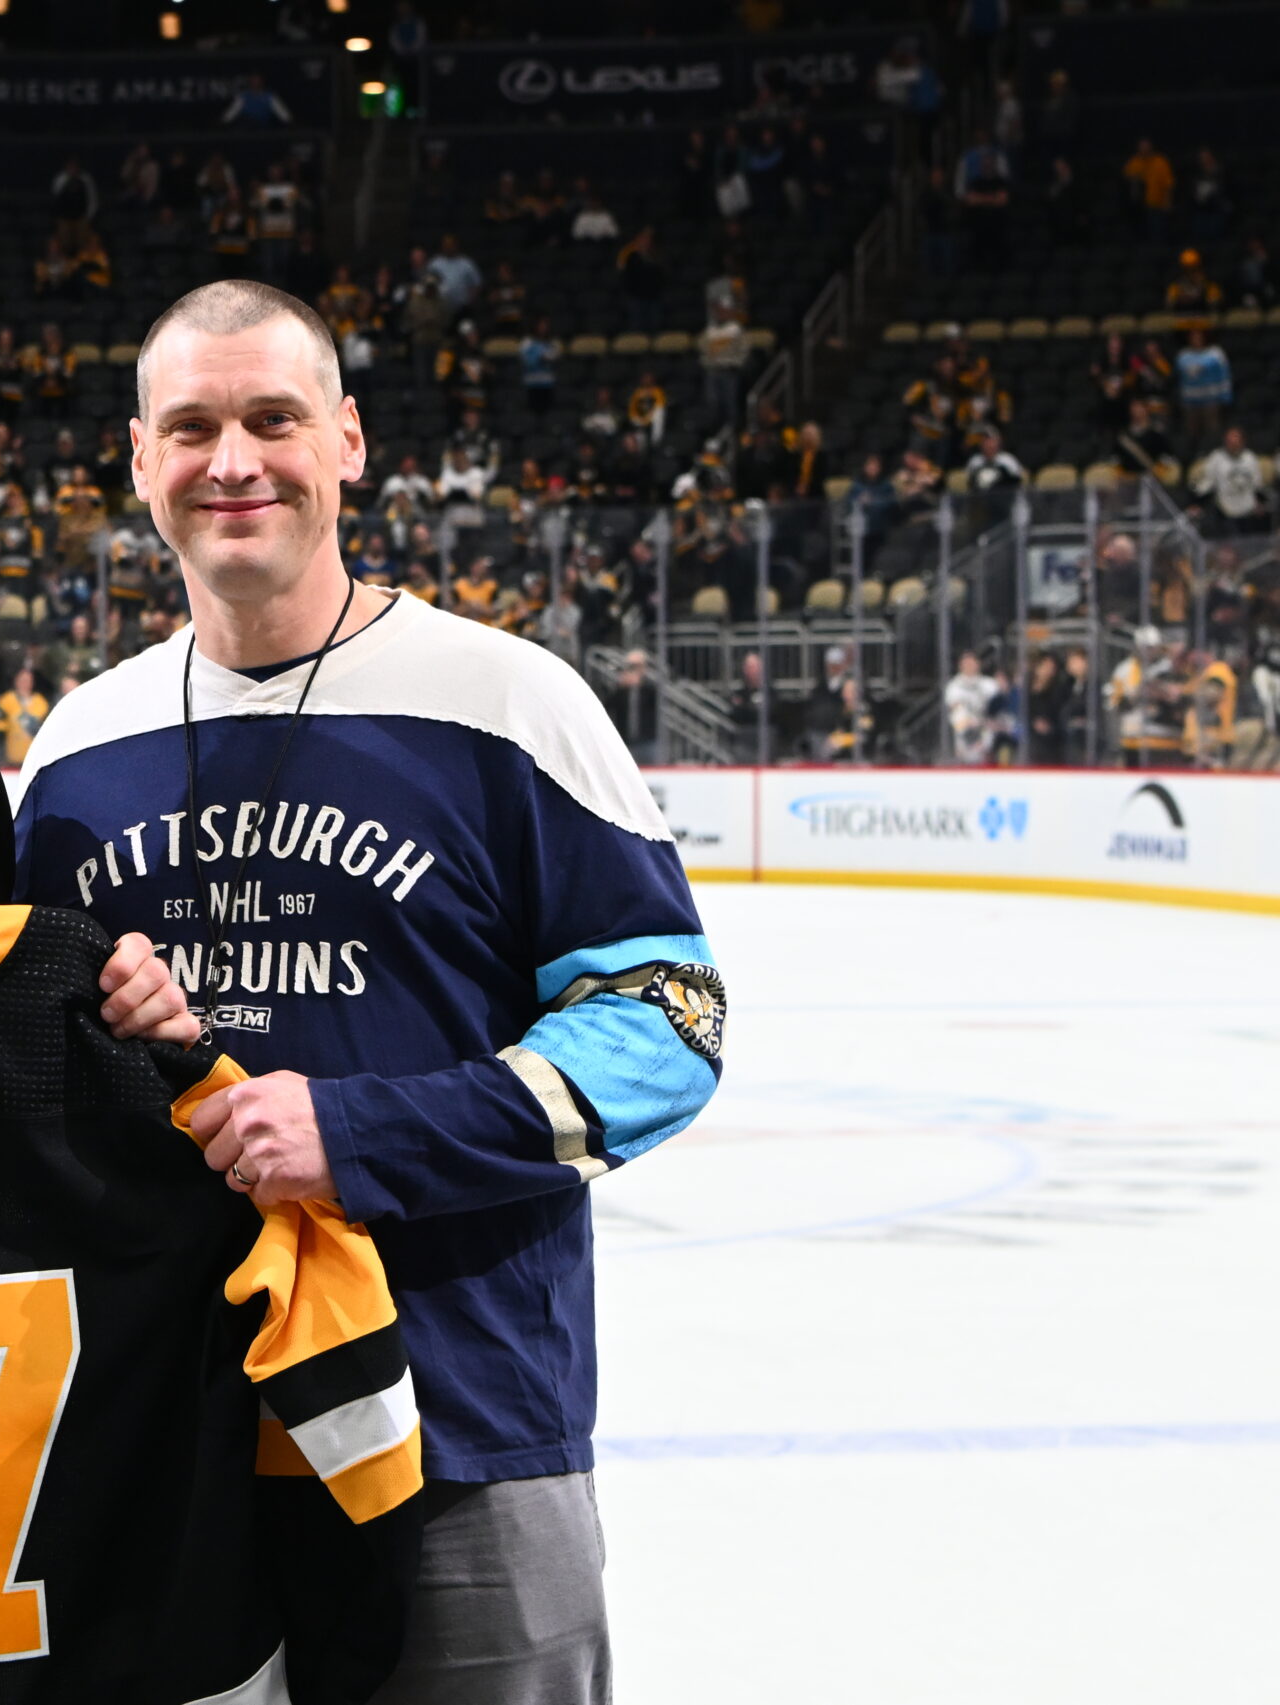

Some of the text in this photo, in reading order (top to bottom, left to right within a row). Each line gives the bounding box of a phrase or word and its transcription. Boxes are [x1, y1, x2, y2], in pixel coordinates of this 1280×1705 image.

[562, 61, 722, 95] LEXUS
[808, 802, 973, 841] HIGHMARK
[76, 800, 435, 907] PITTSBURGH
[163, 880, 316, 924] EST. NHL 1967
[152, 940, 369, 996] NGUINS
